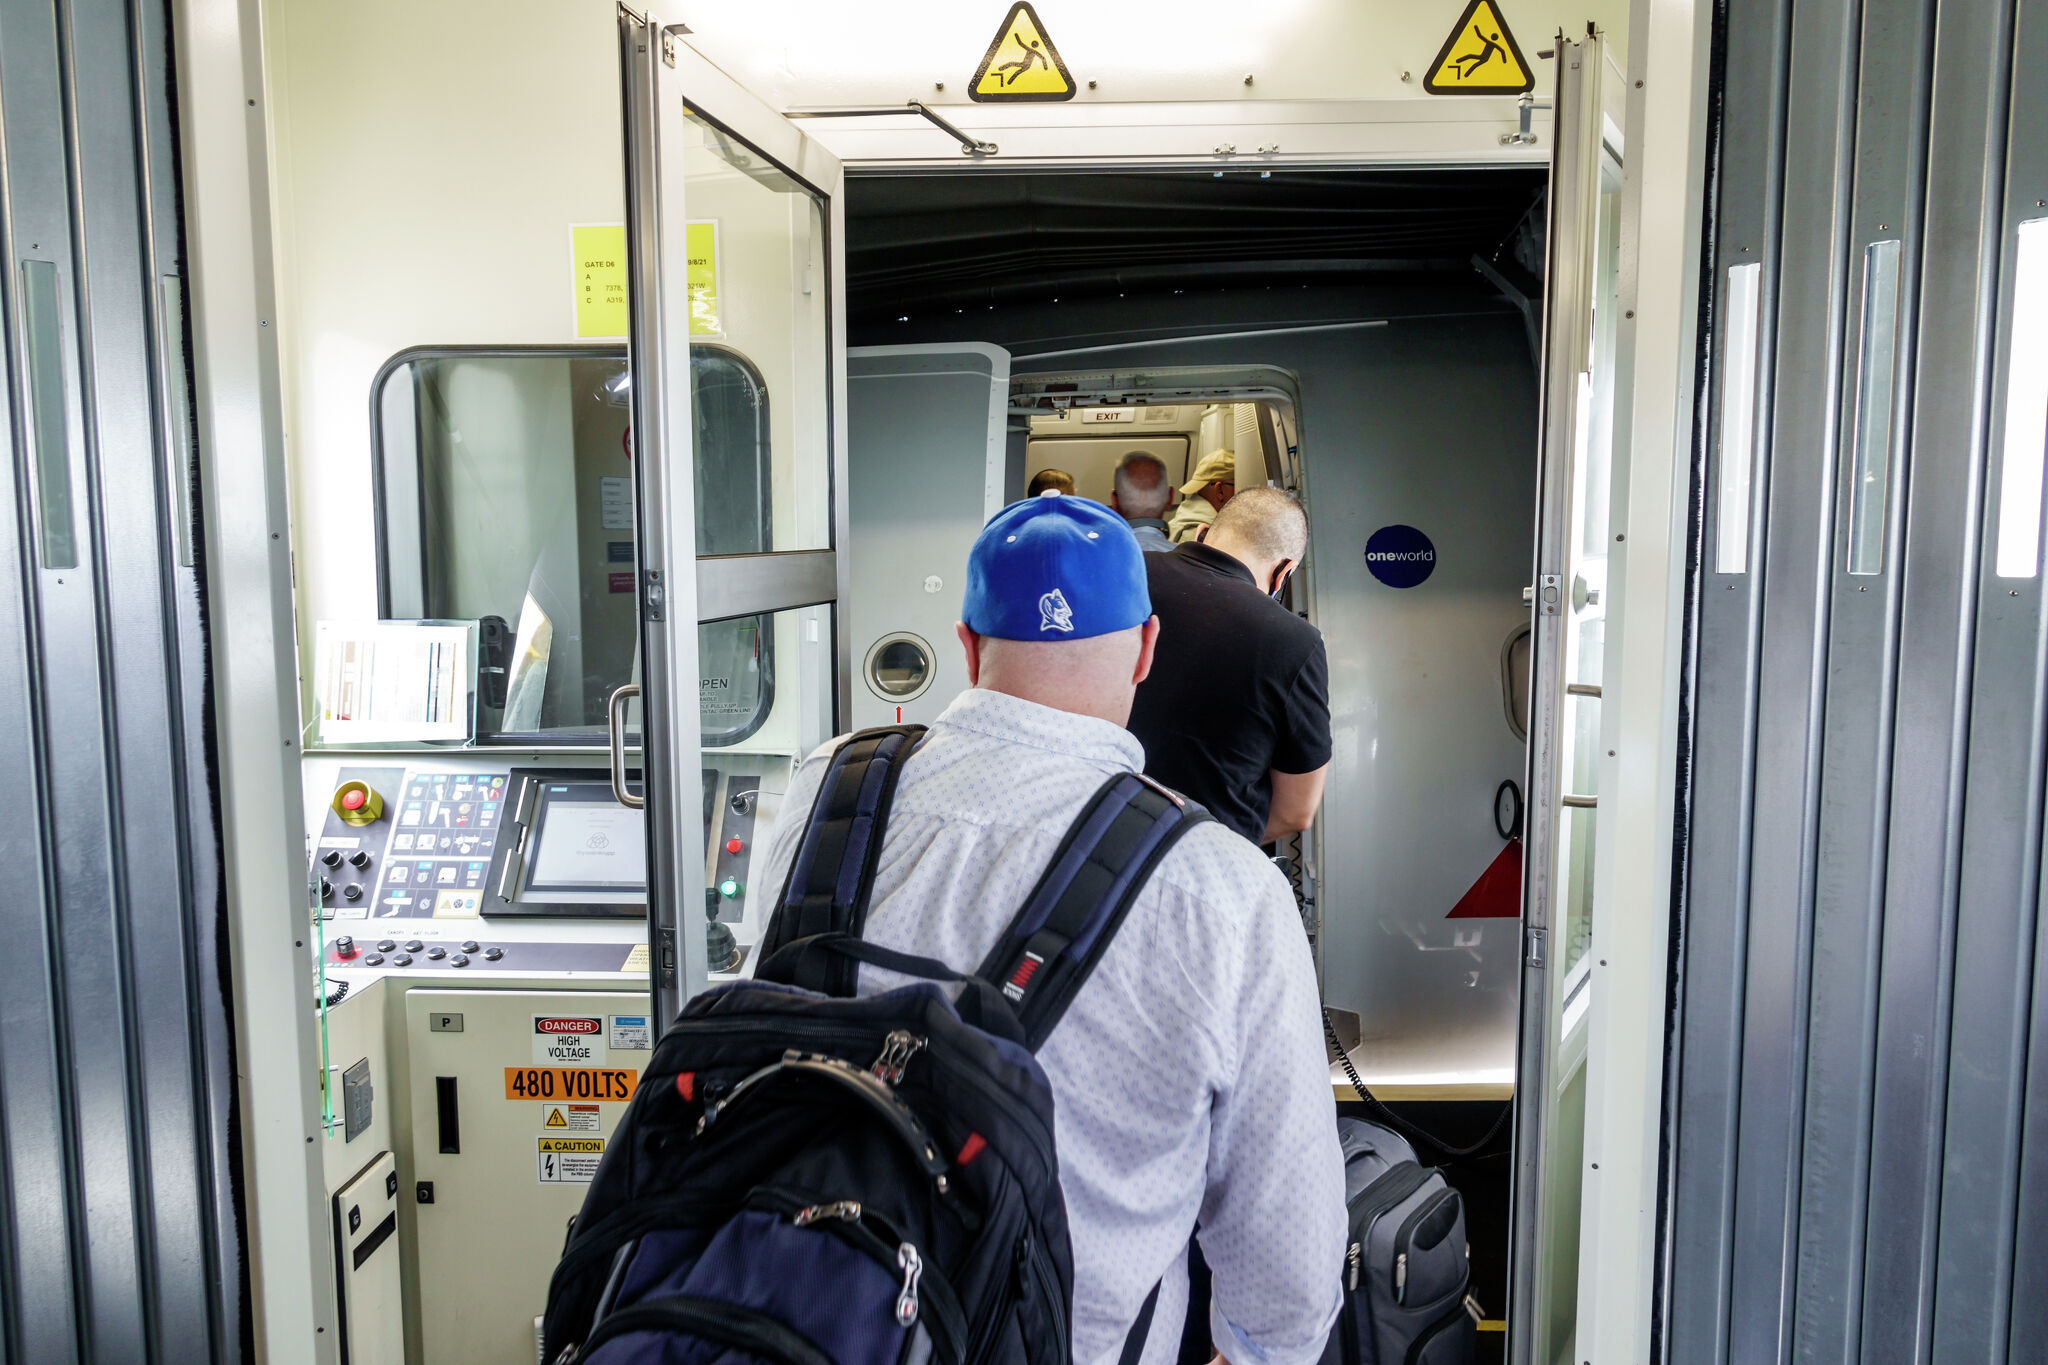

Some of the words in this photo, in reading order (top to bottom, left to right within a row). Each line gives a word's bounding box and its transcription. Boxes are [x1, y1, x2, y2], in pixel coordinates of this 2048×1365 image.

[1096, 412, 1121, 421] EXIT
[1367, 549, 1433, 562] oneworld
[699, 678, 728, 689] PEN
[442, 1017, 451, 1028] P
[544, 1021, 592, 1031] DANGER
[557, 1035, 580, 1046] HIGH
[548, 1047, 591, 1058] VOLTAGE
[513, 1070, 554, 1097] 480
[562, 1070, 628, 1098] VOLTS
[554, 1141, 601, 1151] CAUTION
